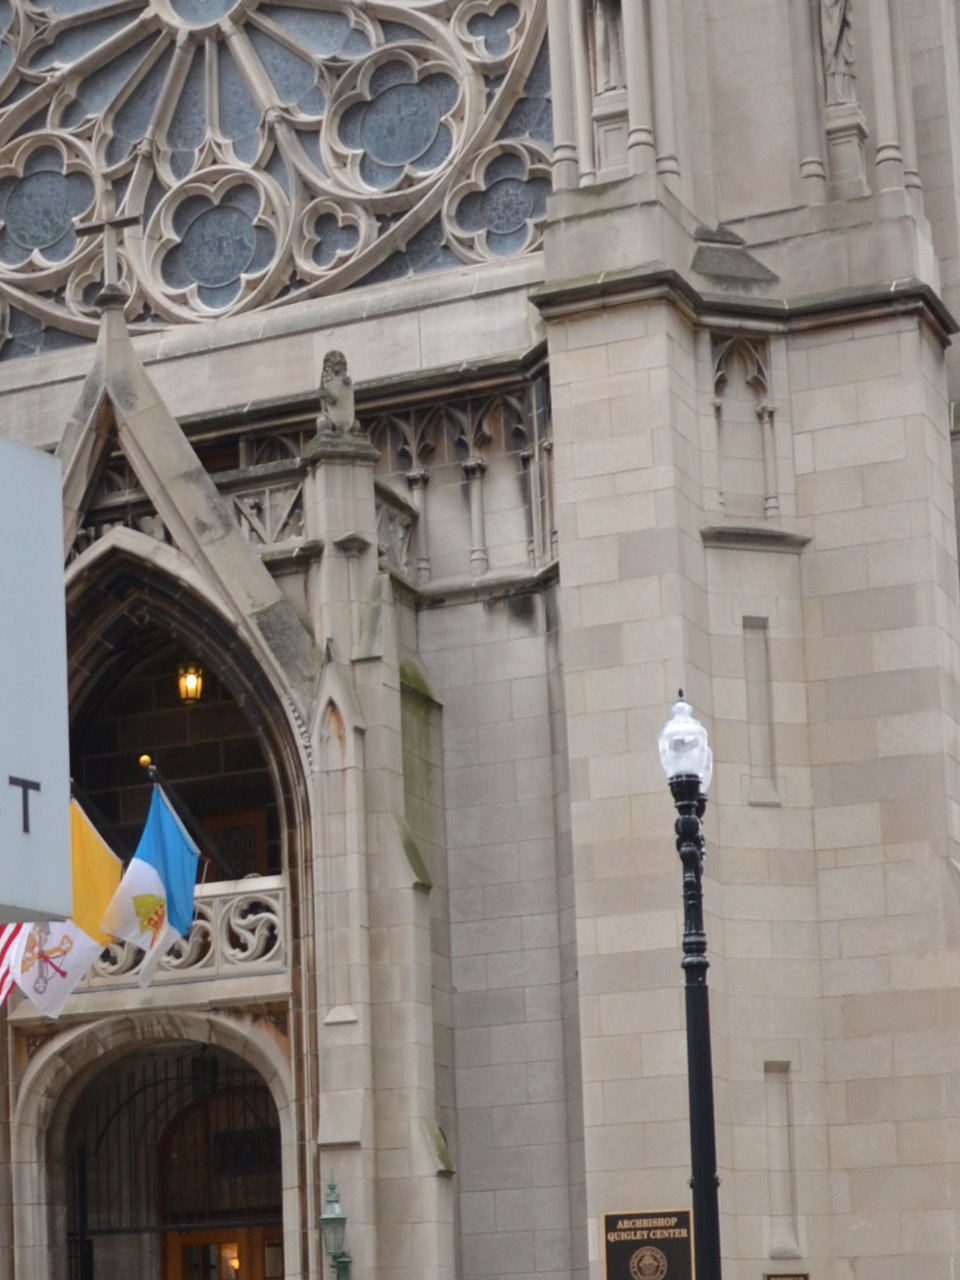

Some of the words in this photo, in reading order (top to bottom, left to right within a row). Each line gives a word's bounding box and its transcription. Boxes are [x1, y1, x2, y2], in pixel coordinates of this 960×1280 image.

[616, 1216, 678, 1229] ARCHBISHOP
[607, 1230, 649, 1242] QUIGLEY
[650, 1228, 688, 1239] CENTER
